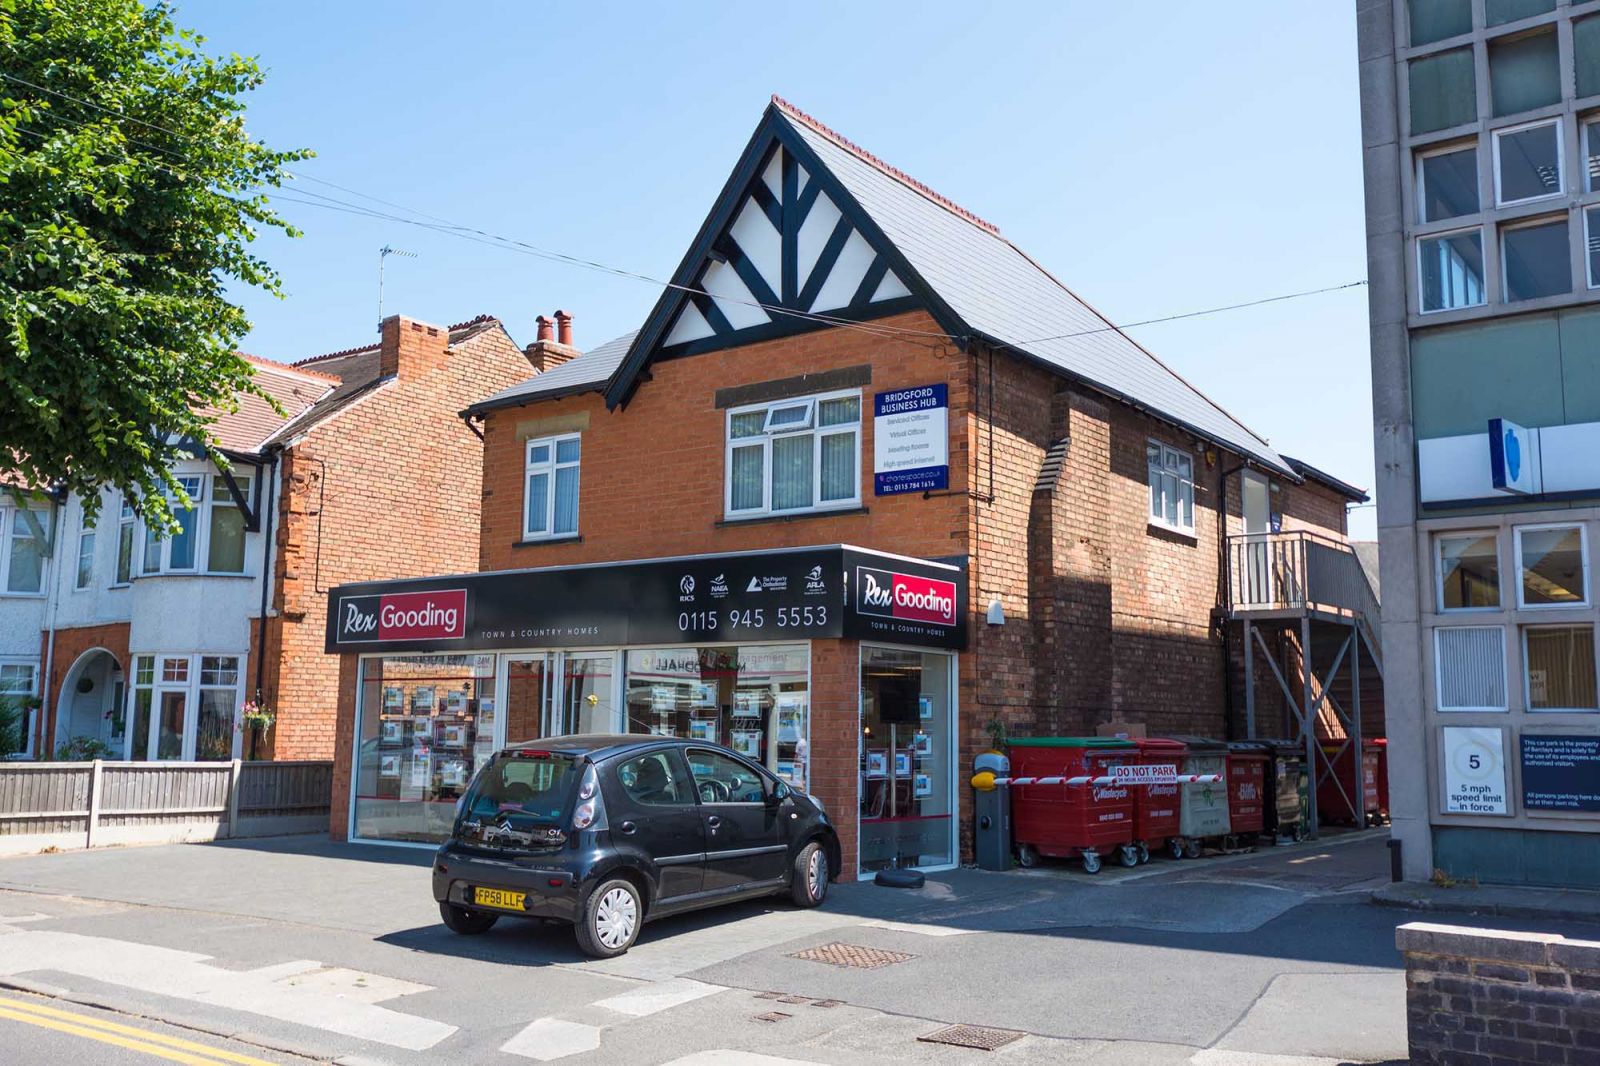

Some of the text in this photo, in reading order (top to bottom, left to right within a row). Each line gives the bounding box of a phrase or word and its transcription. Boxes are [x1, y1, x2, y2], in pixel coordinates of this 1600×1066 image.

[885, 388, 933, 403] BRIDGFORD
[881, 397, 937, 413] BUSINESS HUB
[894, 483, 908, 491] 0115
[806, 581, 825, 589] ARLA
[863, 574, 952, 619] Rex Gooding
[344, 601, 457, 633] Rex Gooding
[678, 606, 827, 631] 0115 945 5553
[482, 627, 598, 639] TOWN & COUNTRY HOMES
[871, 622, 888, 630] TOWN
[898, 625, 924, 634] COUNTRY
[927, 628, 945, 636] HOMES
[1469, 754, 1481, 769] 5
[1116, 766, 1175, 777] DO NOT PARK
[1461, 784, 1491, 795] 5 mph
[1451, 794, 1502, 803] speed limit
[1460, 802, 1468, 811] in
[1470, 803, 1494, 811] force
[478, 889, 523, 907] FP58 LLF
